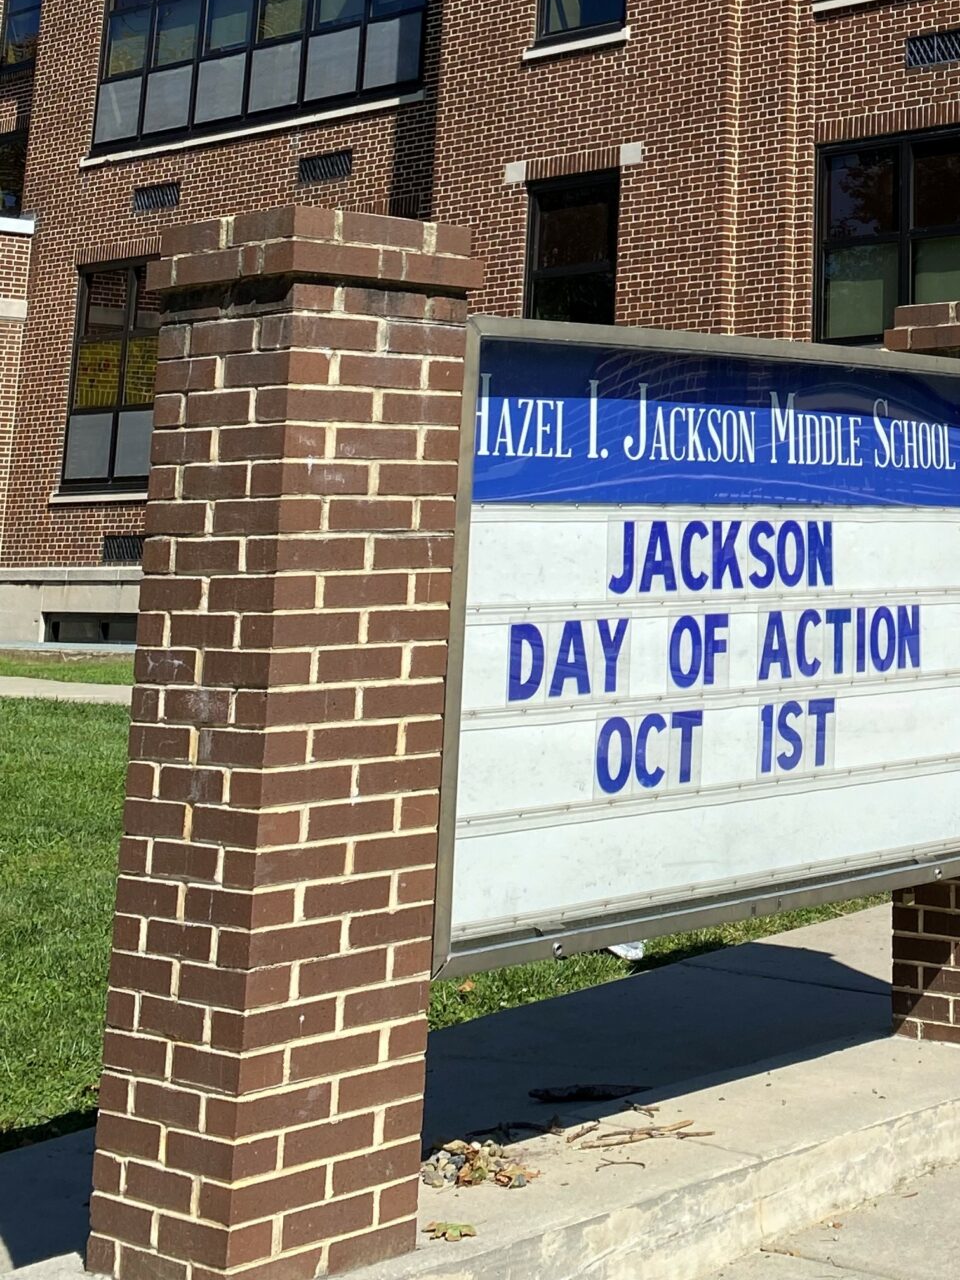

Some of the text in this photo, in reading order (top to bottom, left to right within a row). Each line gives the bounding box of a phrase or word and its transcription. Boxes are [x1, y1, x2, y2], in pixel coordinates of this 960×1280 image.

[587, 379, 608, 459] I.
[624, 382, 755, 463] JACKSON
[770, 391, 863, 467] MIDDLE
[873, 398, 956, 470] SCHOOL
[608, 520, 833, 594] JACKSON
[508, 604, 921, 702] DAY OF ACTION
[596, 697, 835, 794] OCT 1ST
